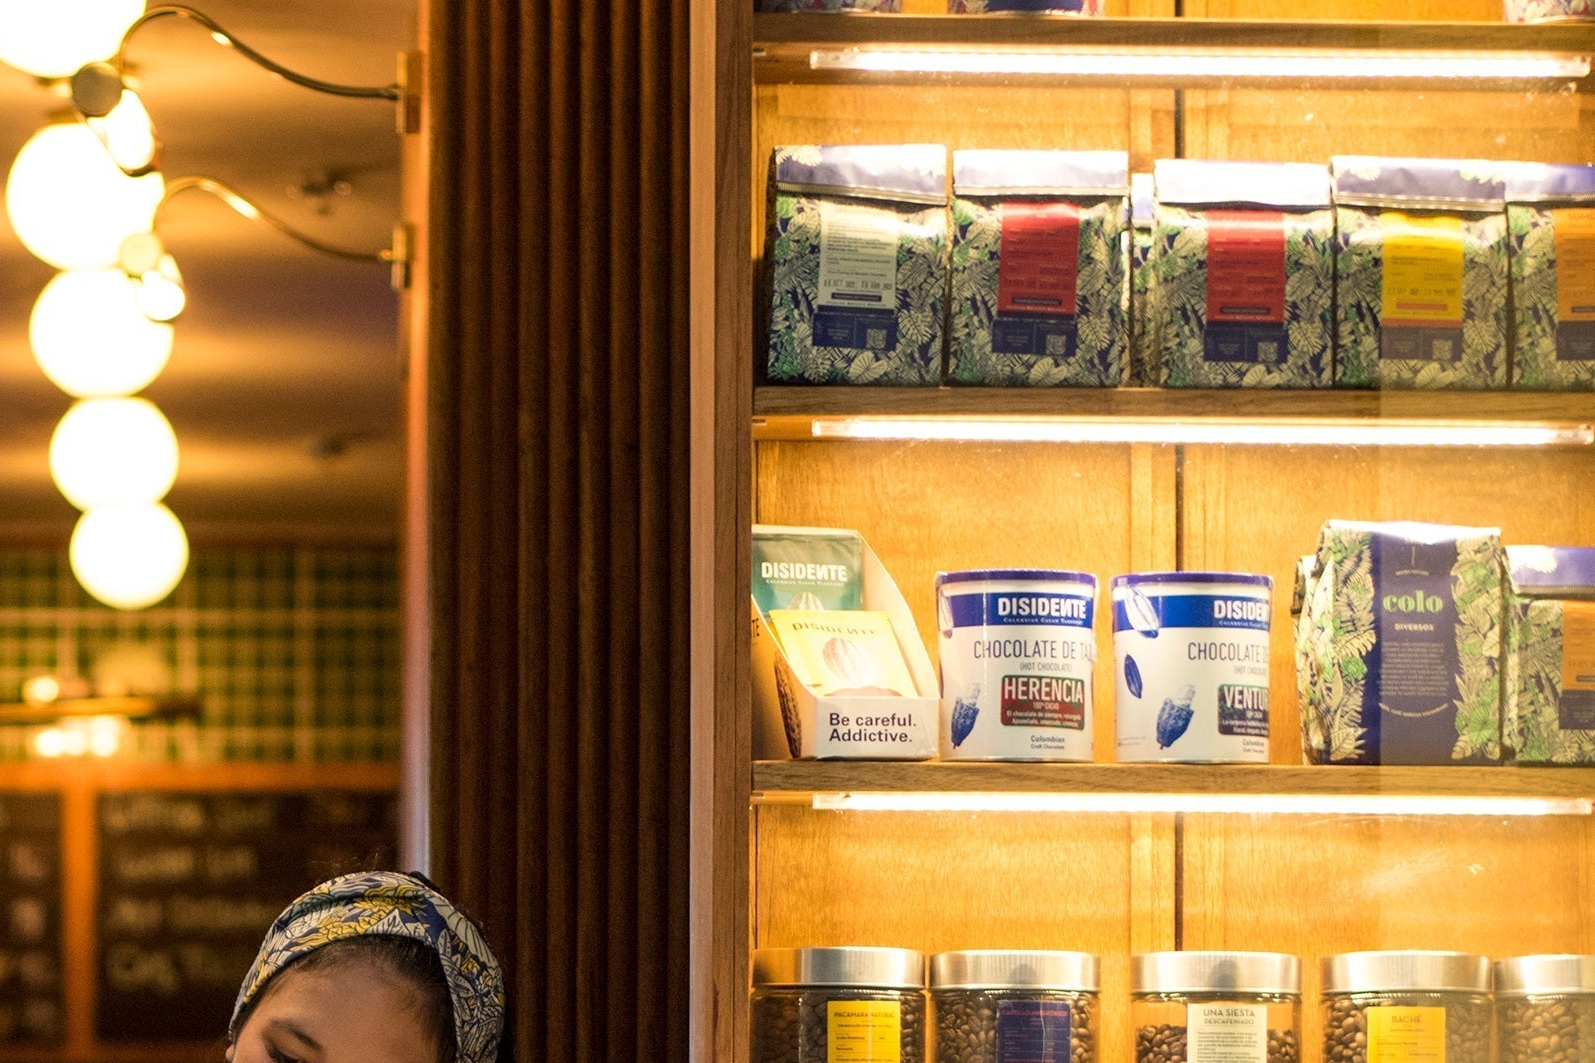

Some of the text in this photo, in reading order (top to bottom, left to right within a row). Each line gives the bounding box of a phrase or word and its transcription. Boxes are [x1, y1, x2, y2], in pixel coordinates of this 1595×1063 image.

[1383, 590, 1443, 613] colo
[1394, 623, 1434, 631] DIVERSOS
[974, 639, 1057, 659] CHOCOLATE
[1062, 641, 1076, 660] DE
[1188, 642, 1260, 663] CHOCOLATE
[1004, 677, 1084, 704] HERENCIA
[829, 712, 916, 727] Be careful.
[829, 728, 912, 743] Addictive.
[1030, 735, 1065, 743] Colombian
[1203, 1009, 1255, 1017] UNA SIESTA
